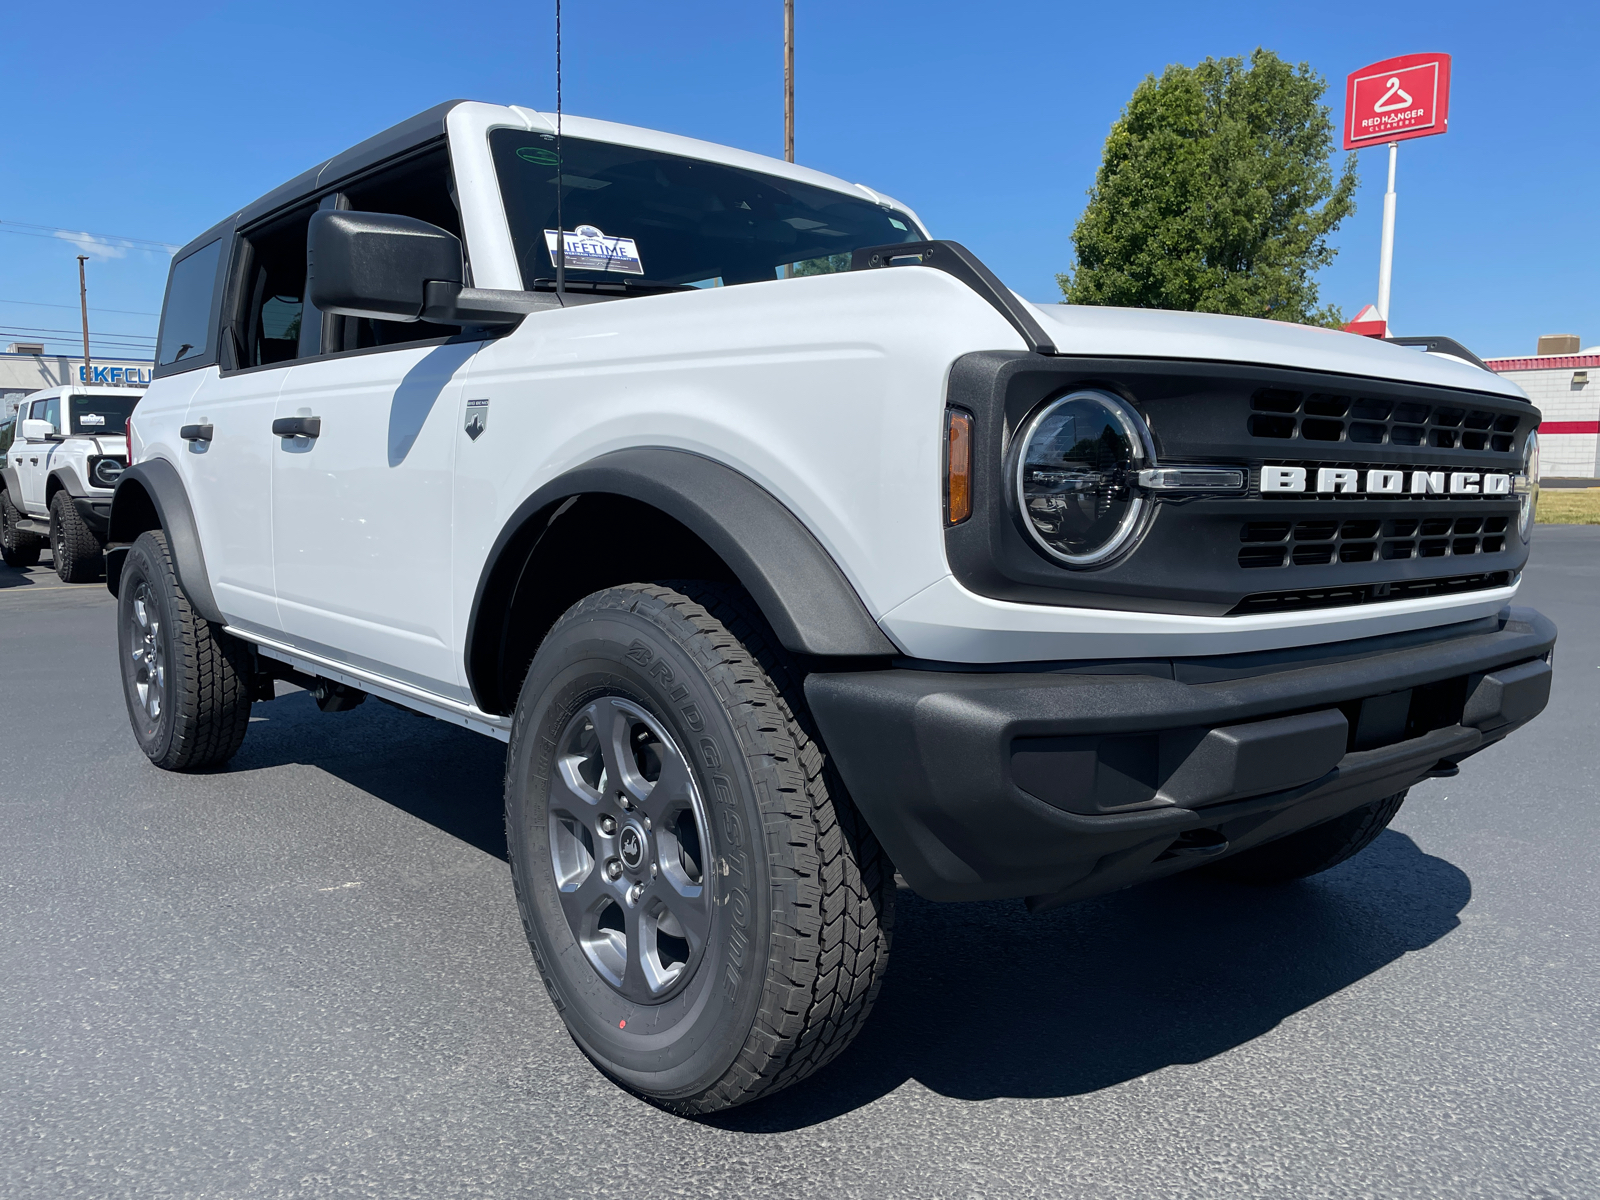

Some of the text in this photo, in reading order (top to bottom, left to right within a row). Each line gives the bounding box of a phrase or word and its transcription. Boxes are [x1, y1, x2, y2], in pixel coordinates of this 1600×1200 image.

[1362, 109, 1424, 127] RED HANGER
[1369, 119, 1415, 131] CLEANERS
[1260, 465, 1511, 495] BRONCO
[625, 638, 751, 1002] BRIDGESTONE
